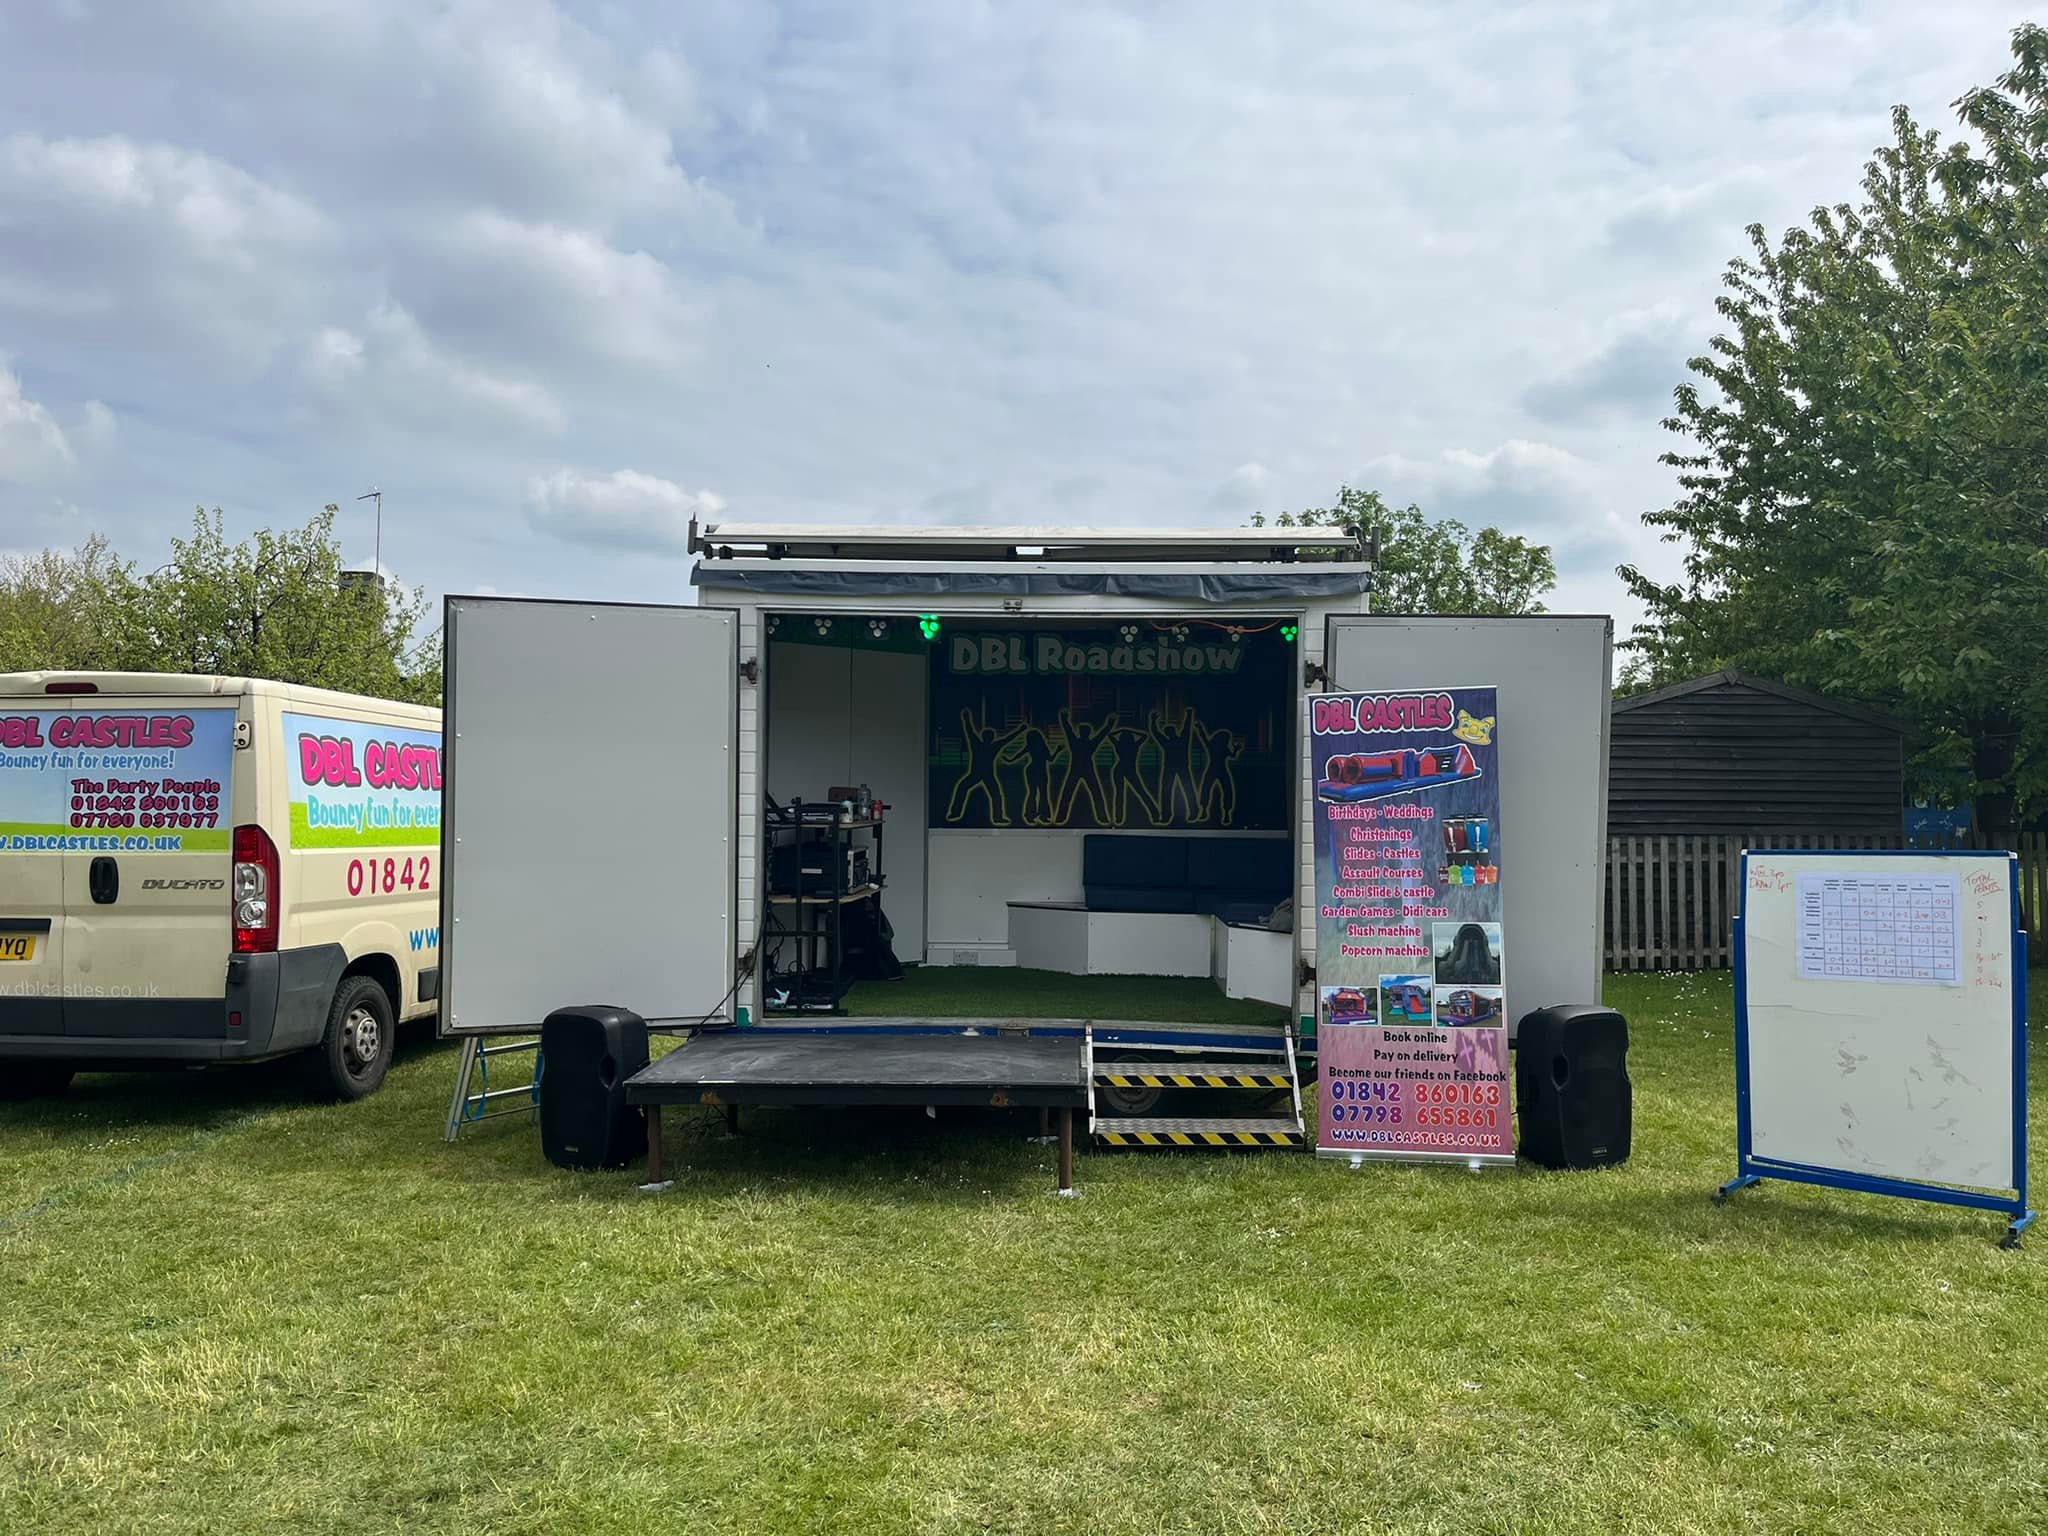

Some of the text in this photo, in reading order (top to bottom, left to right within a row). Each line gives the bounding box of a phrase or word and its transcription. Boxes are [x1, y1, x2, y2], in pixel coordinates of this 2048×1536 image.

[952, 636, 1241, 673] DBL Roadshow
[1313, 693, 1454, 734] DBL CASTLES
[0, 715, 194, 748] BL CASTLES
[51, 751, 73, 768] fun
[77, 751, 99, 768] for
[102, 751, 175, 771] everyone!
[299, 733, 442, 791] DBL CASTL
[71, 779, 220, 797] The Party People
[71, 795, 219, 811] 01842 860163
[70, 812, 135, 828] 07780
[308, 795, 363, 833] Bouncy
[367, 798, 390, 828] fun
[393, 798, 412, 827] for
[1328, 805, 1376, 822] Birthdays
[1384, 805, 1433, 820] Weddings
[1351, 828, 1412, 842] Christenings
[1345, 848, 1375, 859] Slides
[1383, 847, 1420, 859] Castles
[347, 856, 431, 896] 01842
[1343, 868, 1423, 879] Assault Courses
[141, 879, 225, 890] DUCATO
[1333, 886, 1365, 898] Combi
[1367, 886, 1392, 898] Slide
[1403, 886, 1434, 898] castle
[1322, 905, 1357, 917] Garden
[1360, 905, 1394, 917] Games
[1403, 905, 1424, 917] Didi
[1425, 907, 1448, 917] cars
[1348, 924, 1421, 937] Slush machine
[1341, 944, 1429, 958] Popcorn machine
[1383, 1031, 1448, 1043] Book online
[1374, 1050, 1459, 1063] Pay on delivery
[1329, 1066, 1507, 1082] Become our friends on Facebook
[1331, 1080, 1501, 1106] 01842 860163
[1331, 1104, 1497, 1128] 07798 655861
[1331, 1128, 1501, 1147] WWW.DBLCASTLES.CO.UK
